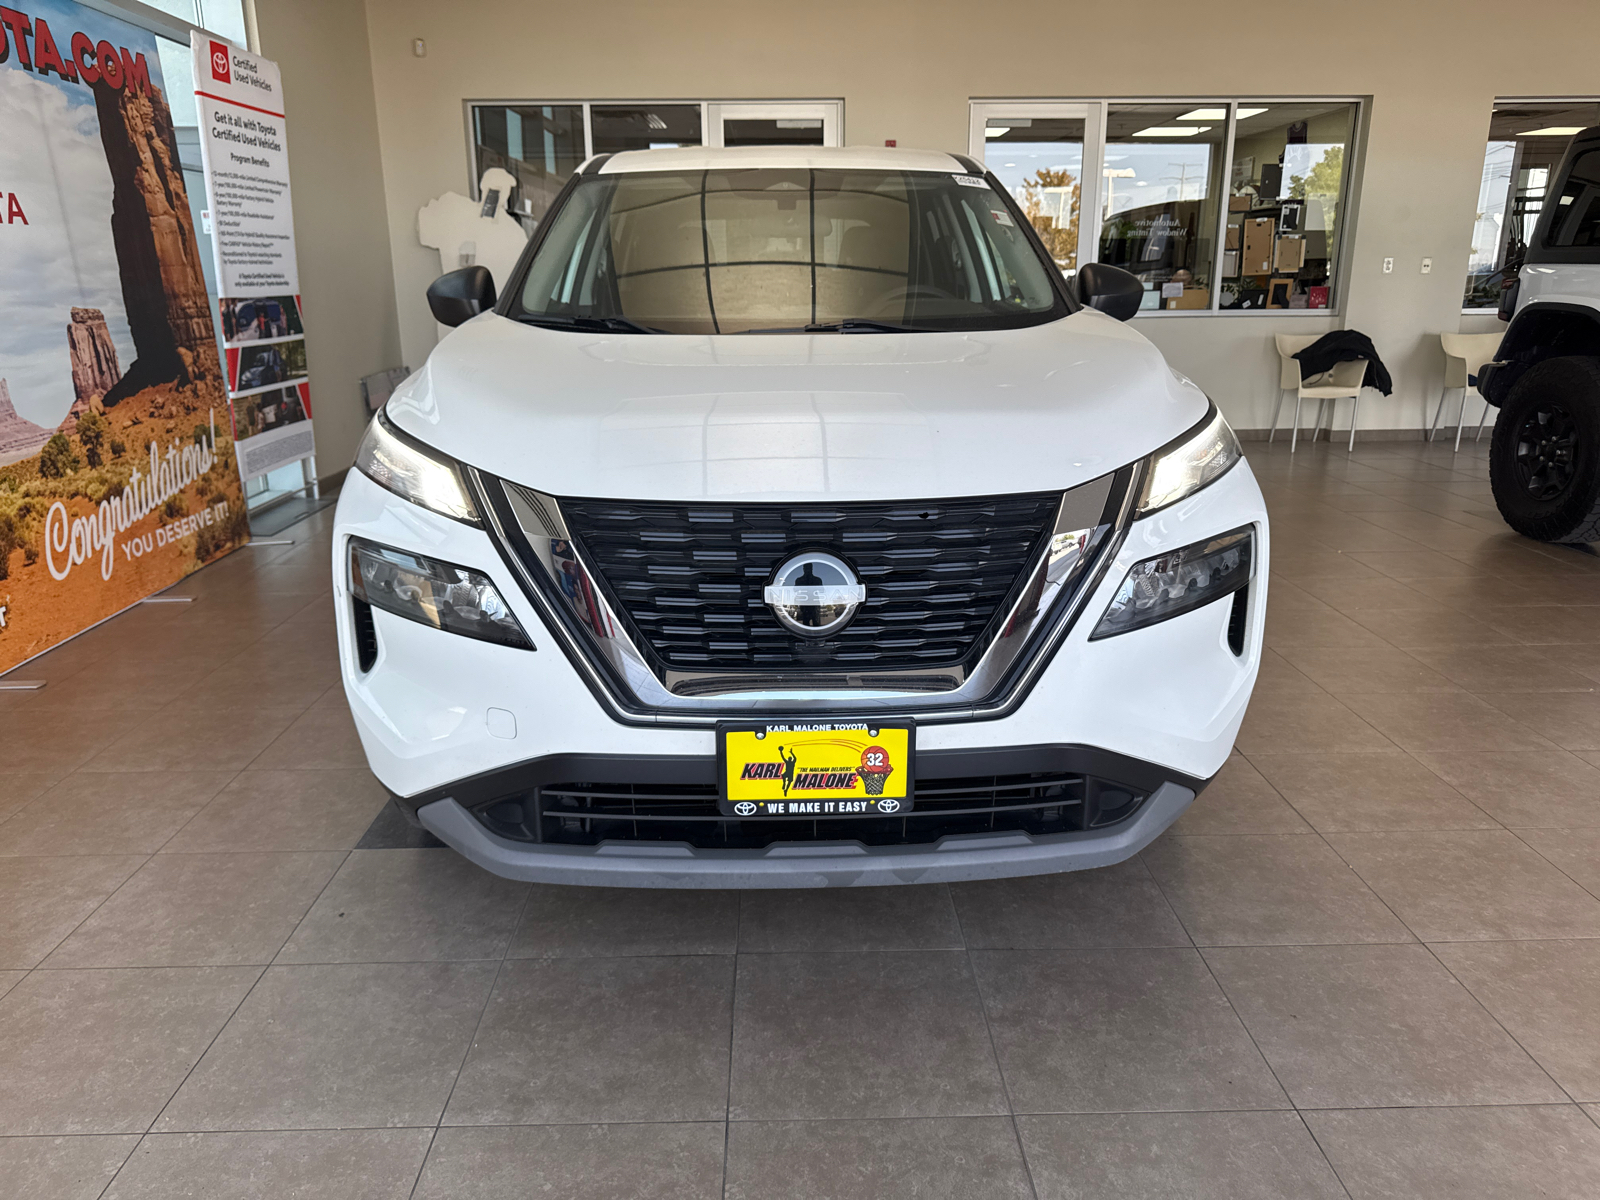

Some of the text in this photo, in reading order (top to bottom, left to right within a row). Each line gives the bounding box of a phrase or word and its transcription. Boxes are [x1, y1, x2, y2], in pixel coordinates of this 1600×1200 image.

[0, 4, 154, 99] TA.COM
[232, 55, 258, 74] Certified
[234, 70, 272, 92] Used Vehicles
[214, 111, 277, 136] Get it all with Toyota
[212, 127, 281, 152] Certified Used Vehicles
[230, 152, 270, 168] Program Benefits
[45, 407, 218, 581] Congratulations!
[121, 500, 230, 562] YOU DESERVE IT!
[768, 586, 864, 603] NISSAN
[766, 723, 869, 733] KARL MALONE TOYOTA
[866, 752, 884, 766] 32
[740, 762, 786, 780] KARL
[791, 772, 858, 790] MALONE
[767, 802, 867, 814] WE MAKE IT EASY
